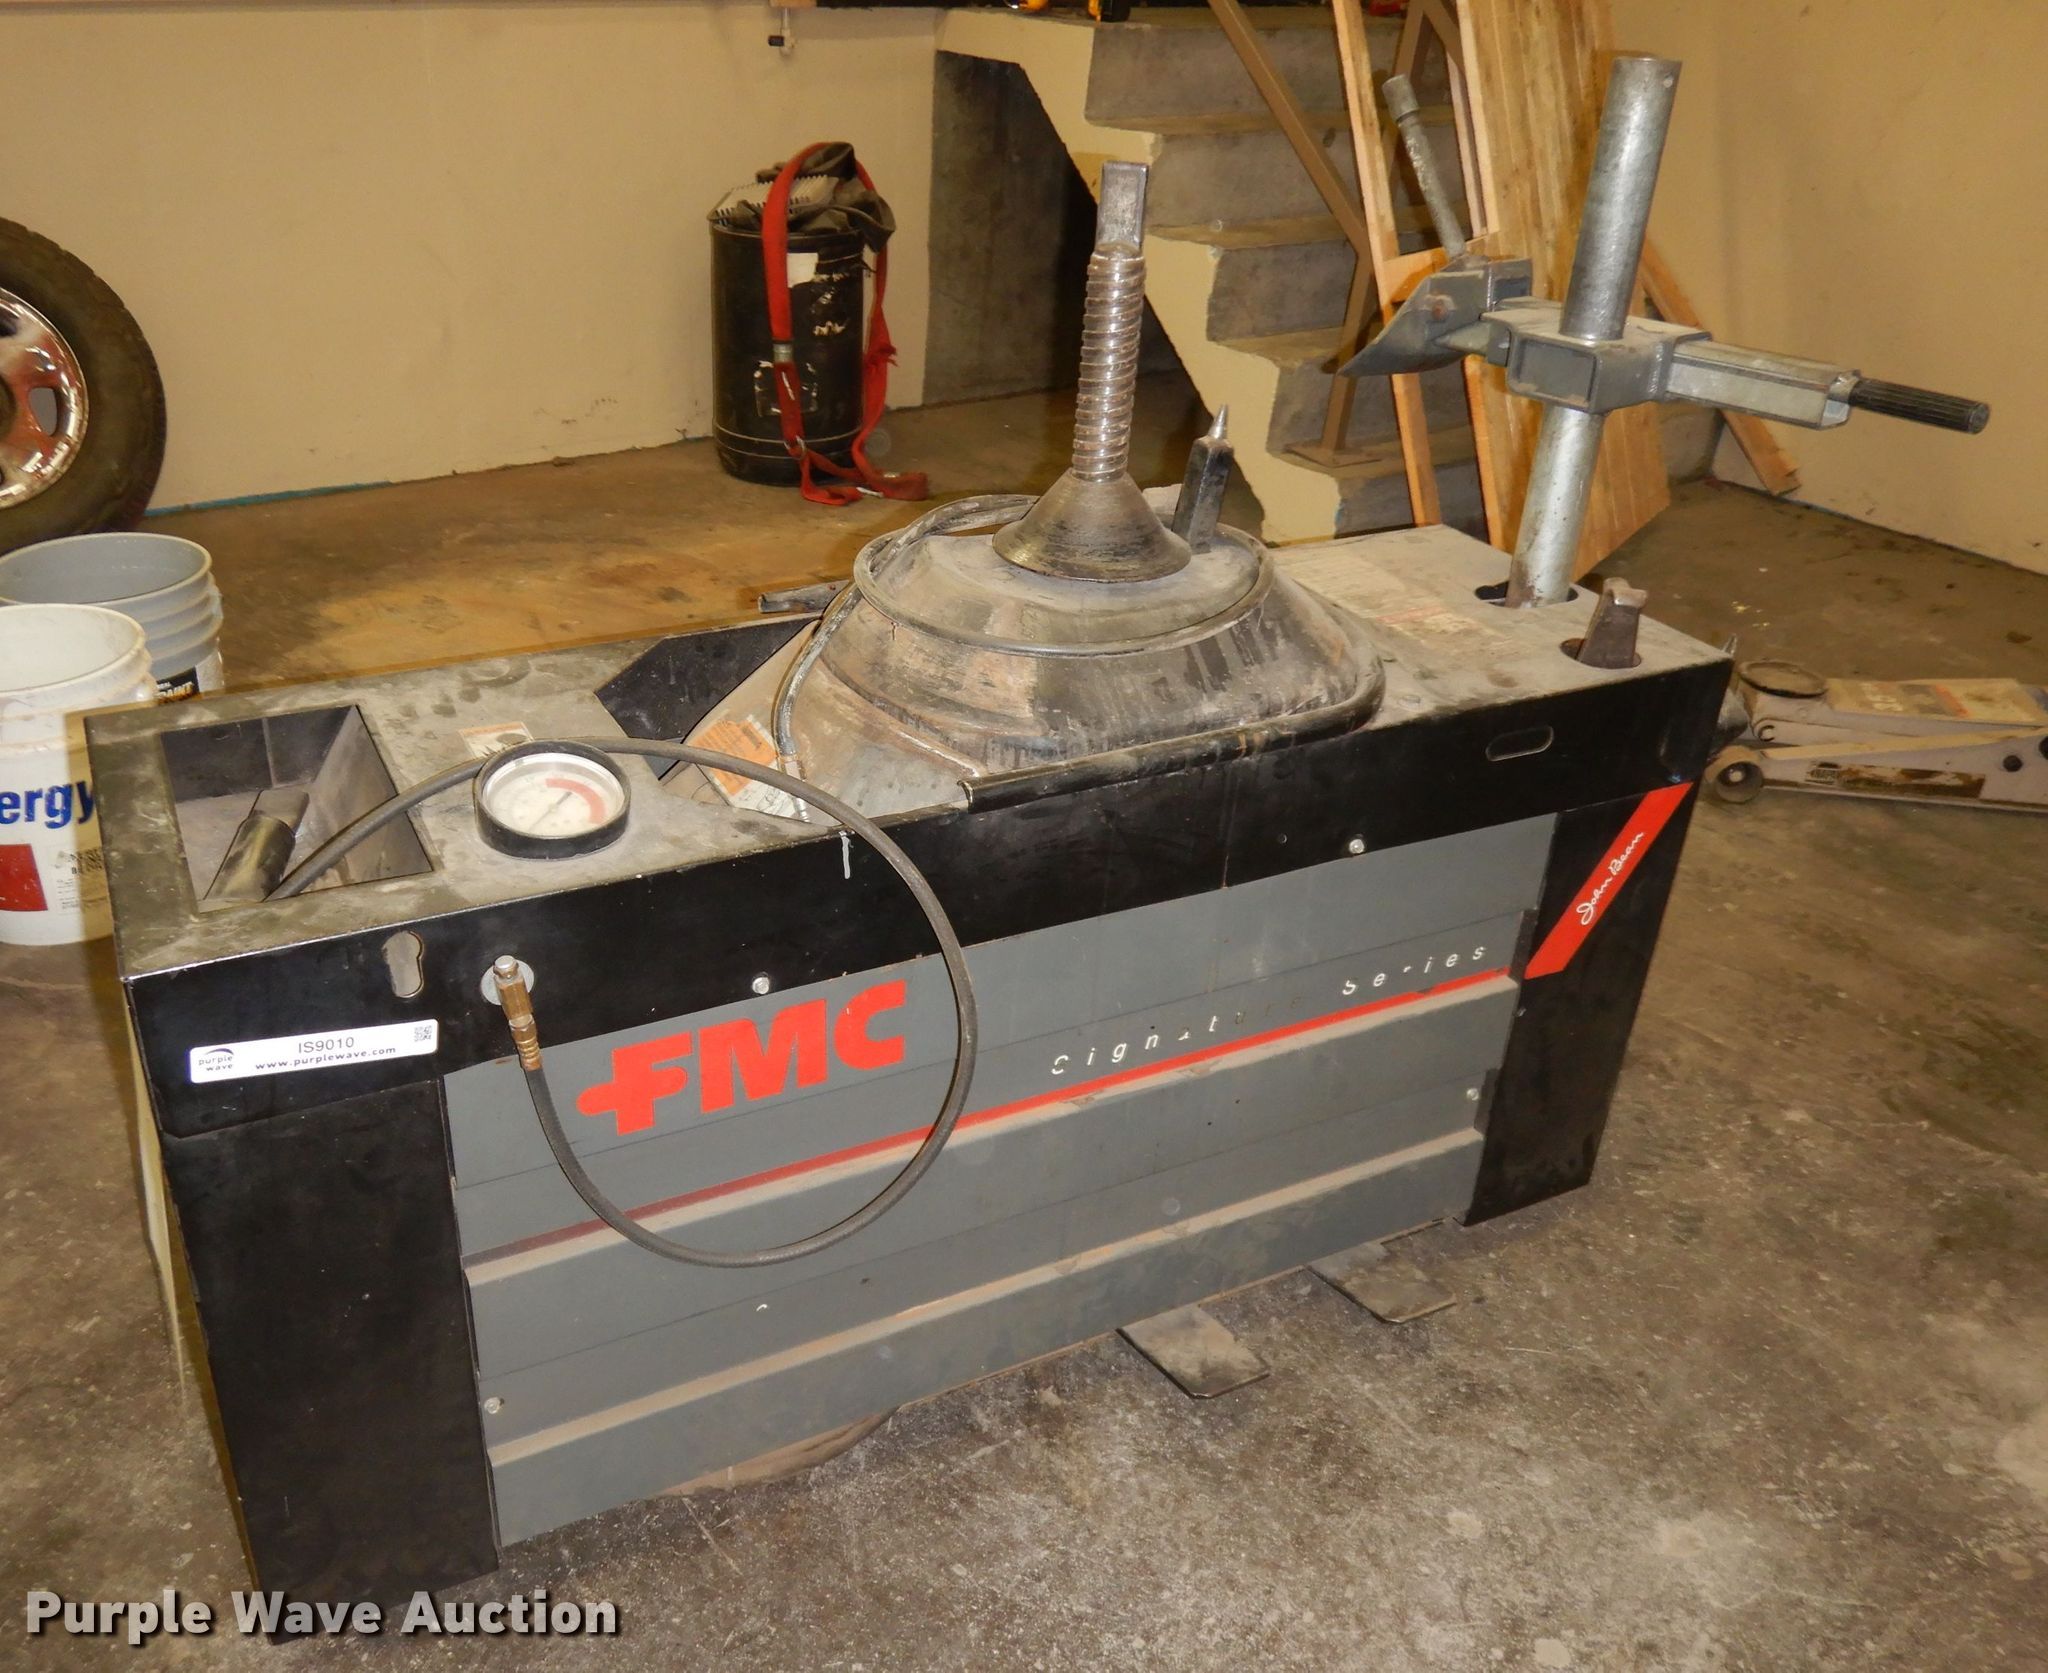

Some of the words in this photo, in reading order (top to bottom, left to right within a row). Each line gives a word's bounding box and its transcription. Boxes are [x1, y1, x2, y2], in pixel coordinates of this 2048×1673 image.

[1576, 876, 1613, 925] John
[1608, 832, 1644, 876] Bean
[298, 1036, 355, 1054] IS9010
[198, 1055, 234, 1066] purple
[206, 1063, 234, 1072] wave
[255, 1047, 396, 1070] www.purplewave.com
[576, 979, 906, 1136] FMC
